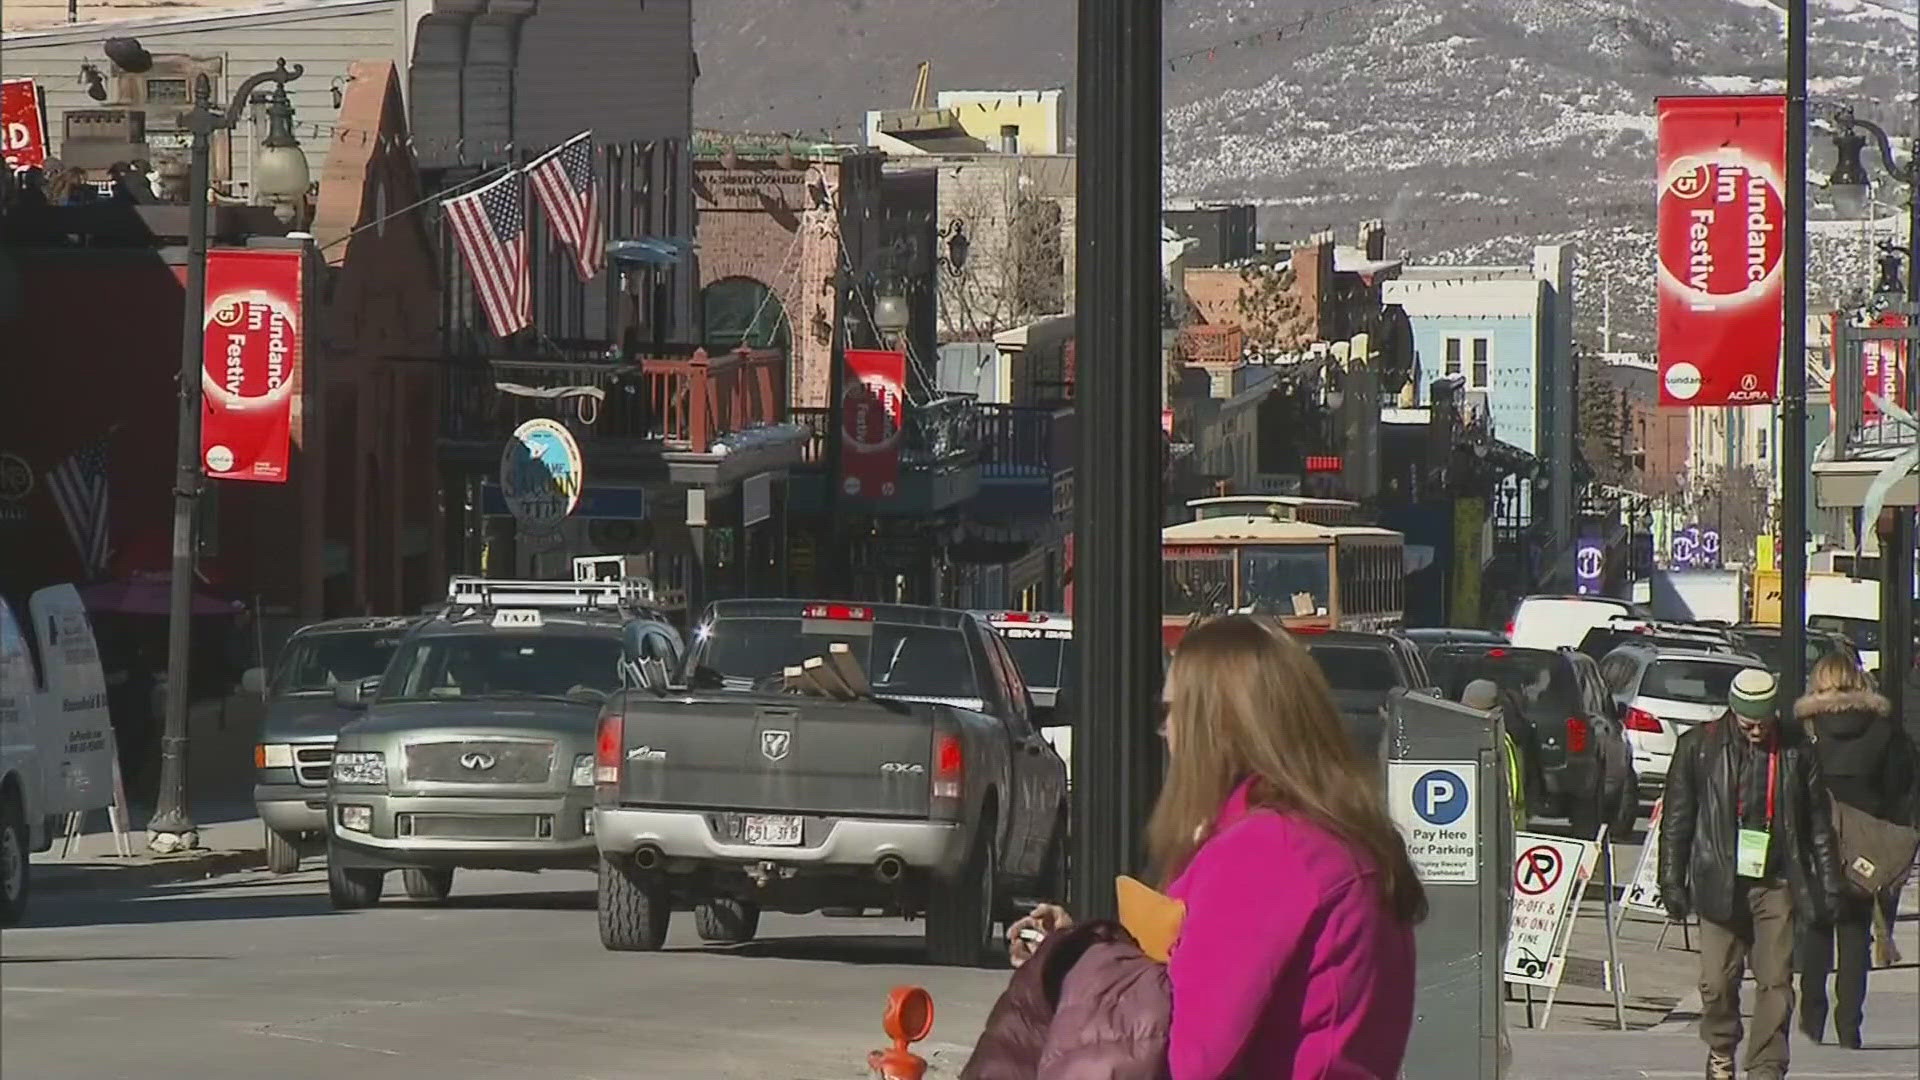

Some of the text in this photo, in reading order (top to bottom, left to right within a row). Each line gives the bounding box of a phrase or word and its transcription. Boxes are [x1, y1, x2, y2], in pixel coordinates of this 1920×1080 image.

[1727, 391, 1769, 401] ACURA
[502, 613, 536, 622] TAXI
[1413, 829, 1467, 841] Pay Here
[1428, 844, 1474, 857] Parking
[1530, 917, 1556, 932] ONLY
[1518, 932, 1540, 945] FINE
